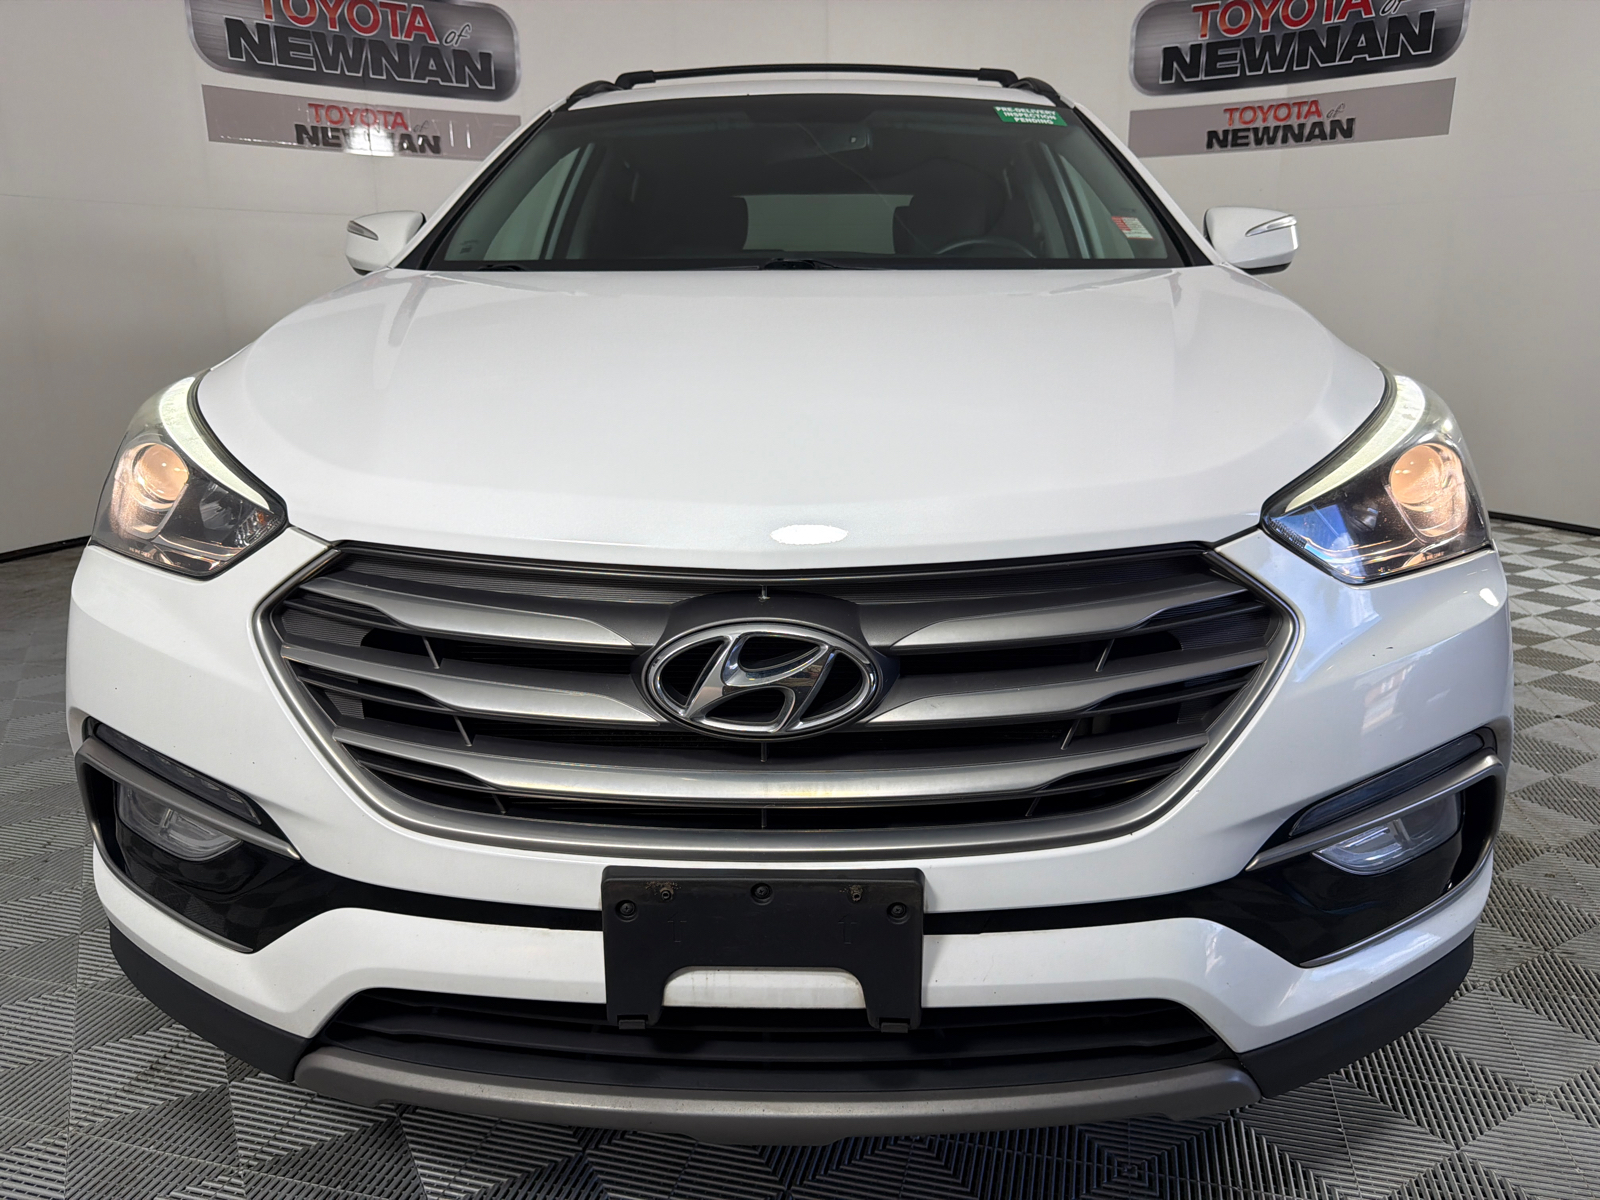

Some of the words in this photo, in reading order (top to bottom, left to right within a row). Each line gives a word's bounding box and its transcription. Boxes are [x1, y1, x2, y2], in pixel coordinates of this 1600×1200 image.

[443, 23, 472, 46] of
[1159, 10, 1437, 84] NEWNAN
[224, 17, 495, 90] NEWNAN
[308, 103, 409, 131] TOYOTA
[994, 106, 1056, 115] PRE-DELIVERY
[1003, 111, 1057, 120] INSPECTION
[1014, 117, 1054, 125] PENDING
[1223, 99, 1322, 126] TOYOTA
[1326, 103, 1346, 119] of
[294, 124, 441, 154] NEAN
[1206, 117, 1356, 149] NEWNAN
